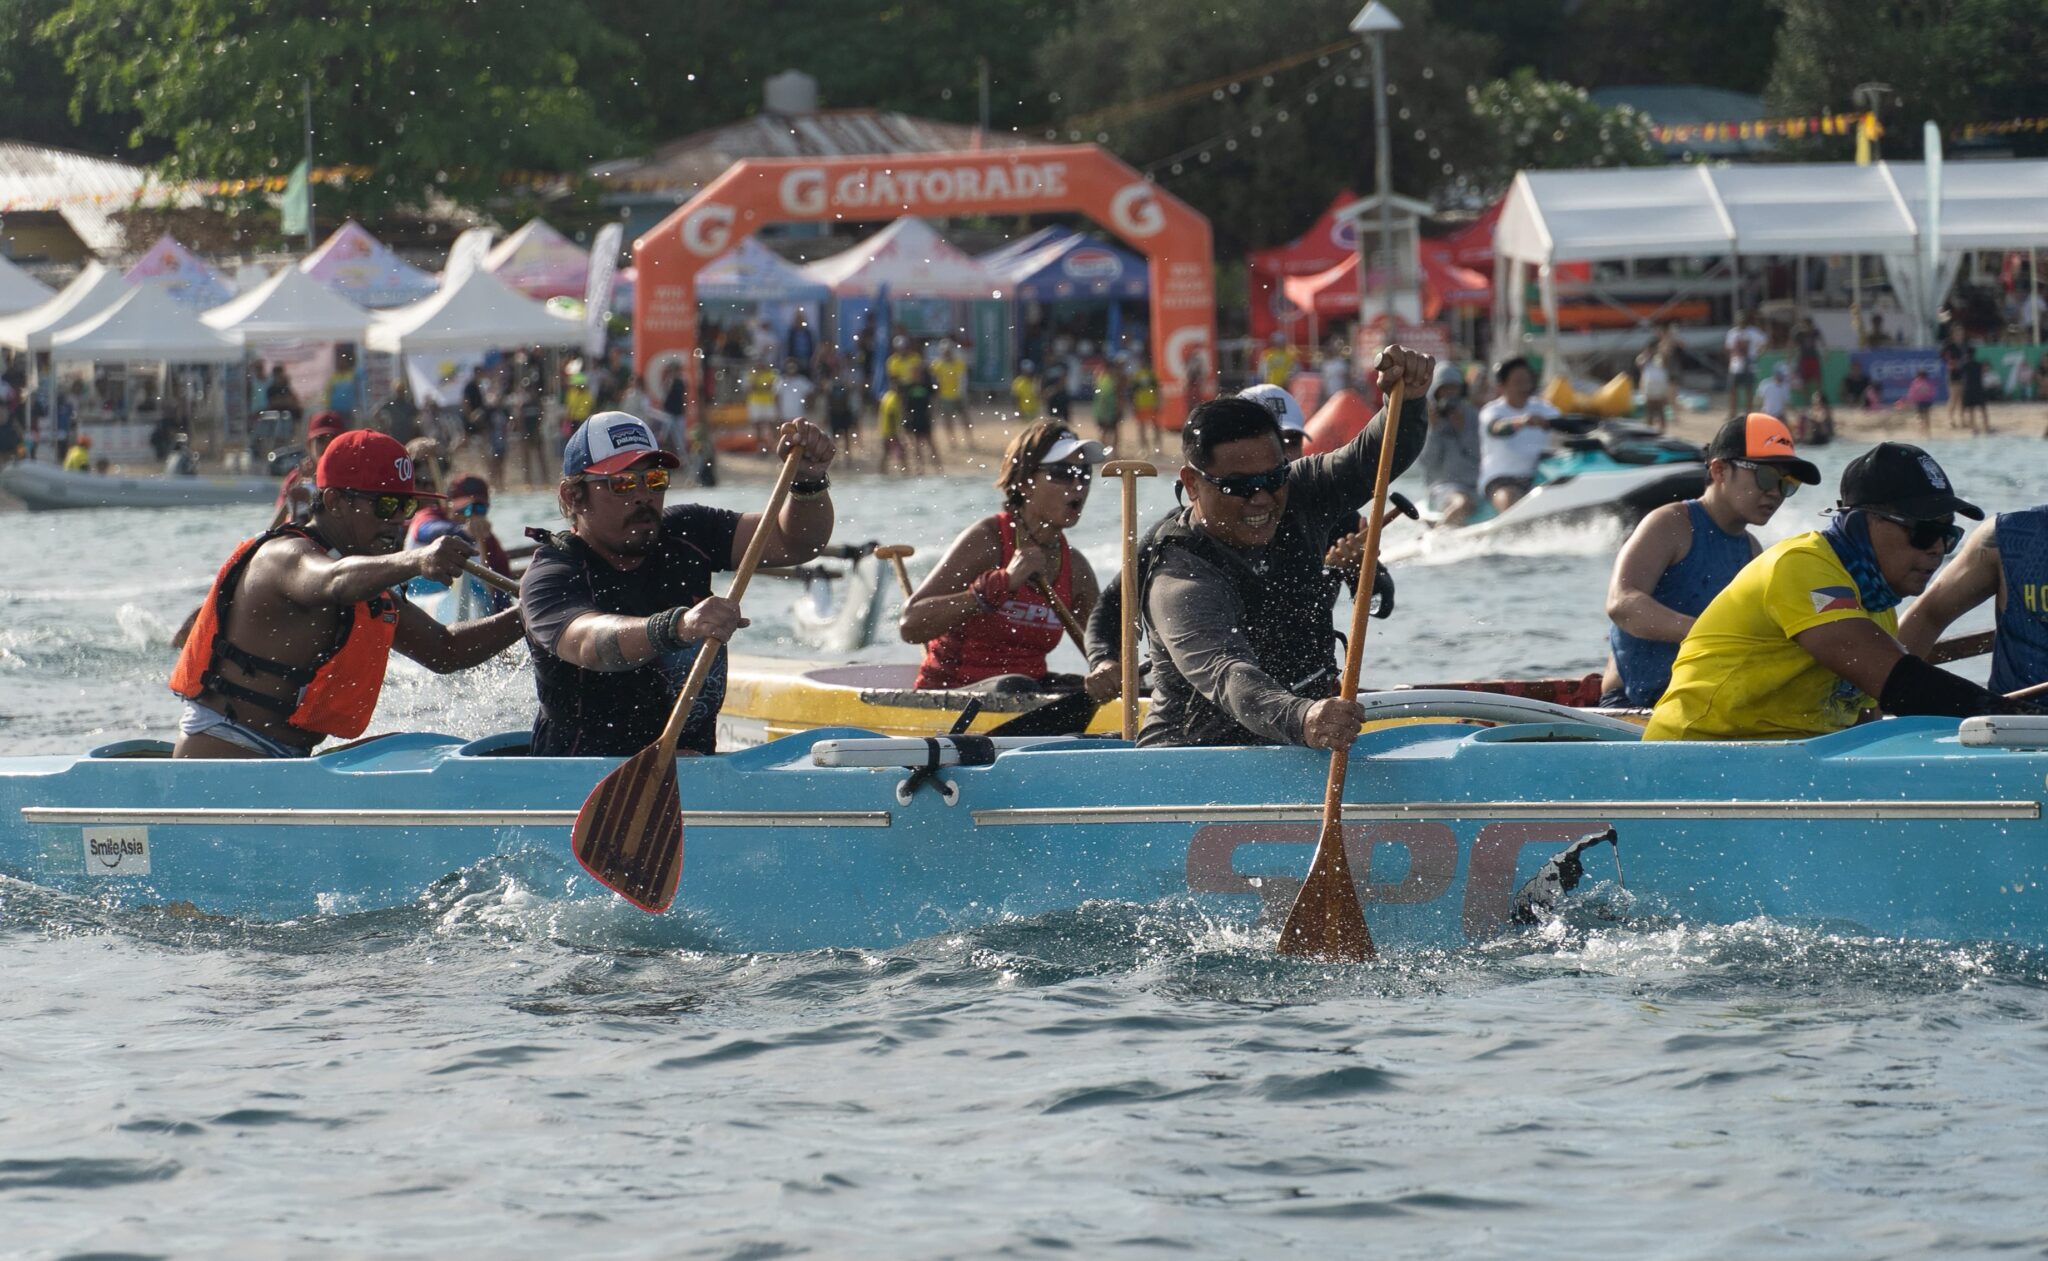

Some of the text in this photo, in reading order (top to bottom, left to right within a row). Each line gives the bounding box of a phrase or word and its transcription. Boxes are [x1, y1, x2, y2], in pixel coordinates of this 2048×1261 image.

[779, 161, 1068, 216] G GATORADE
[1110, 181, 1166, 238] G
[681, 203, 736, 258] G
